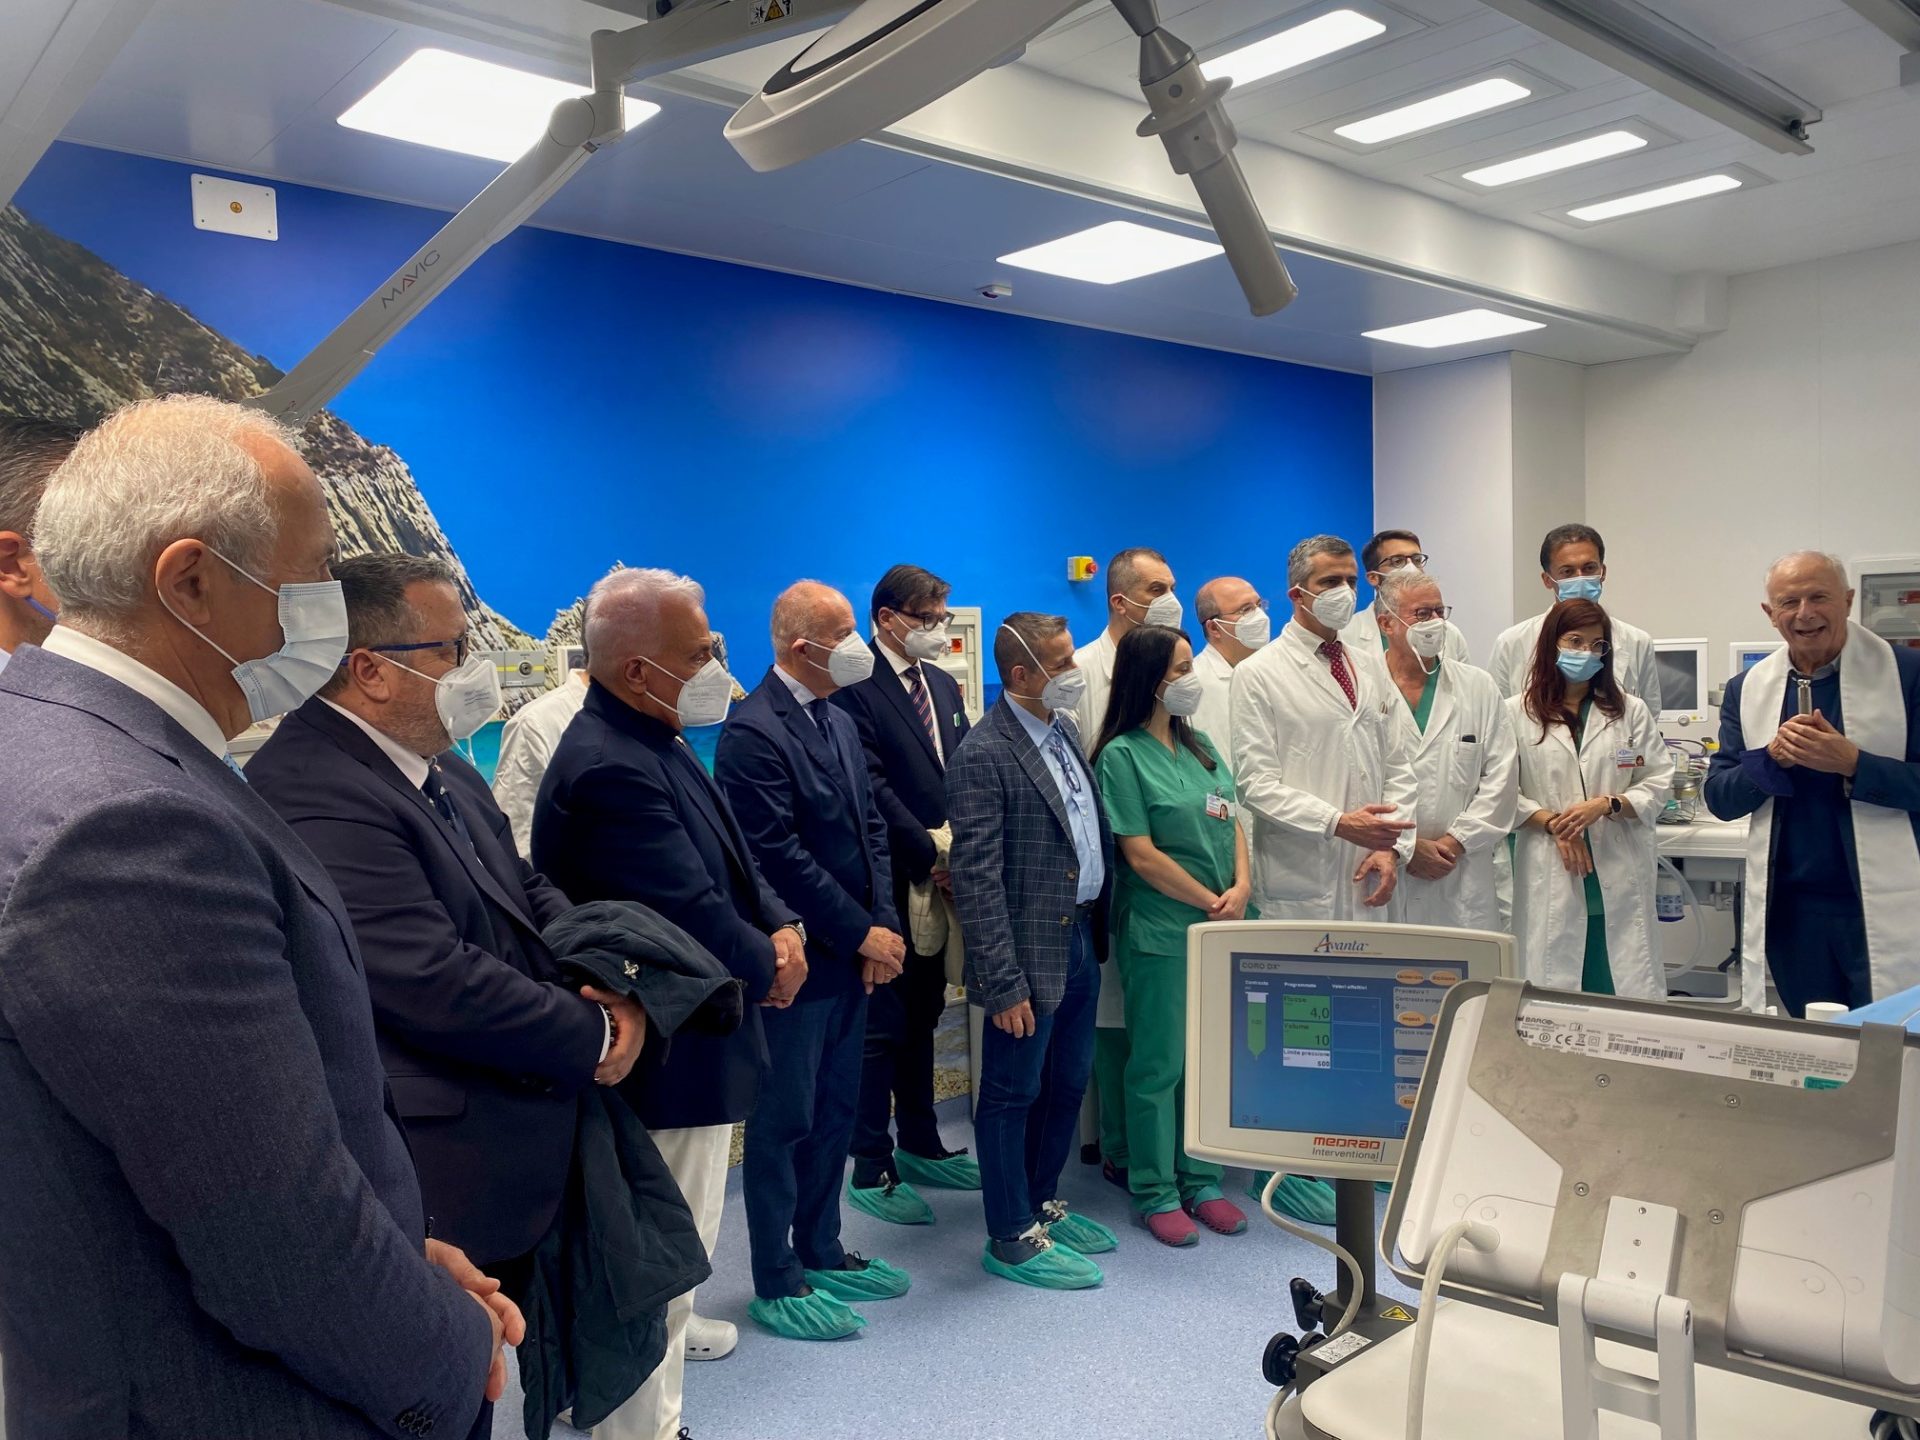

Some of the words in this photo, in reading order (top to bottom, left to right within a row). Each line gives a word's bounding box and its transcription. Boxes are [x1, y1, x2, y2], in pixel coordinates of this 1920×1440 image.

[381, 250, 440, 309] MAVIG
[1313, 932, 1366, 953] Avanta
[1310, 1007, 1330, 1020] 4,0
[1315, 1034, 1330, 1046] 10
[1312, 1147, 1380, 1160] Interventional
